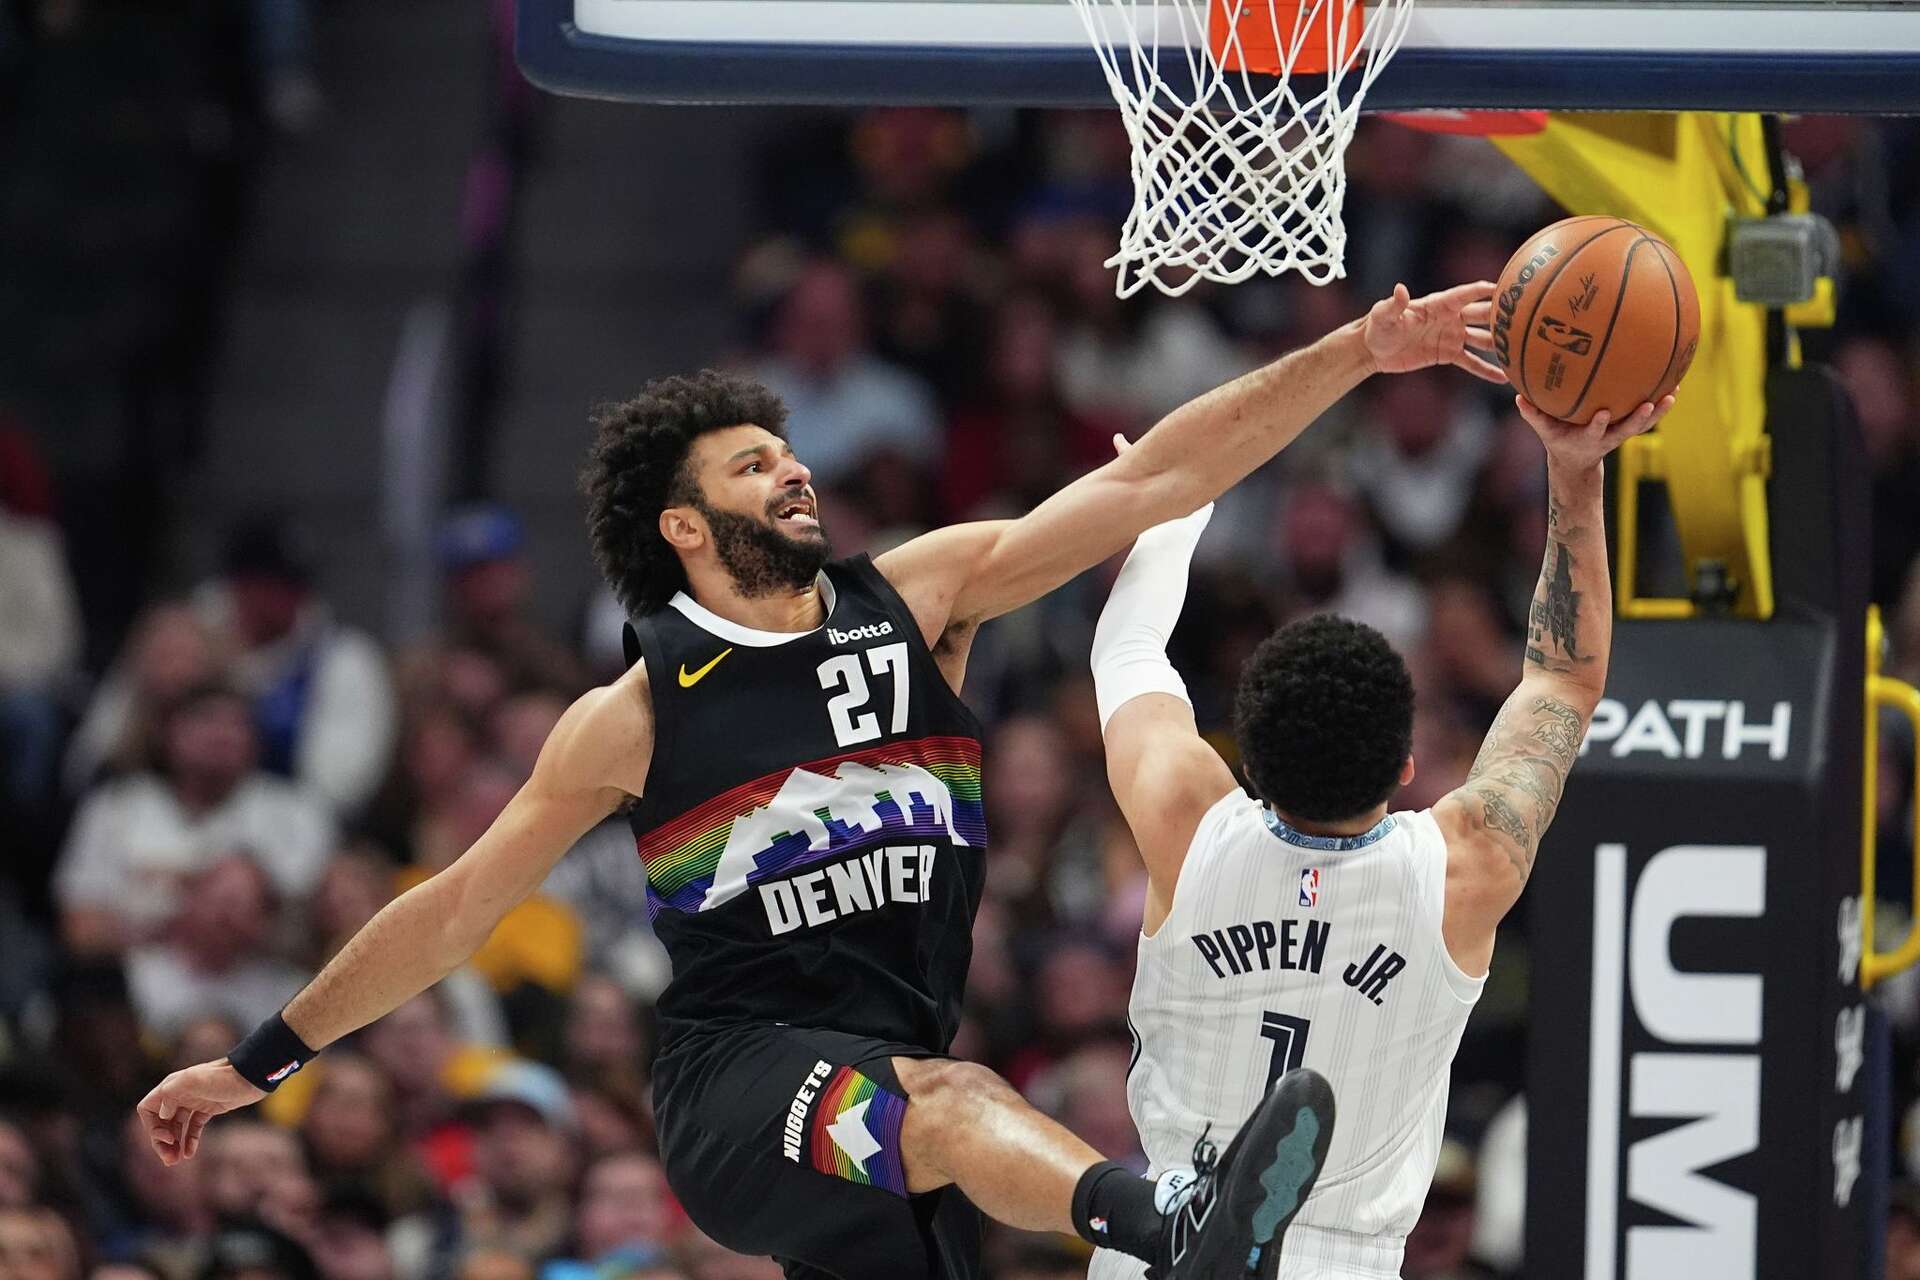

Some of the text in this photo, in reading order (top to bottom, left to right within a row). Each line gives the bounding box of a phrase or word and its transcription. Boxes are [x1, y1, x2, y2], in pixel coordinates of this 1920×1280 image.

[827, 621, 893, 645] ibotta
[816, 642, 910, 748] 27
[1578, 699, 1792, 760] PATH
[758, 844, 937, 936] DENVER
[1191, 919, 1407, 1007] PIPPEN JR.
[783, 1060, 832, 1163] NUGGETS
